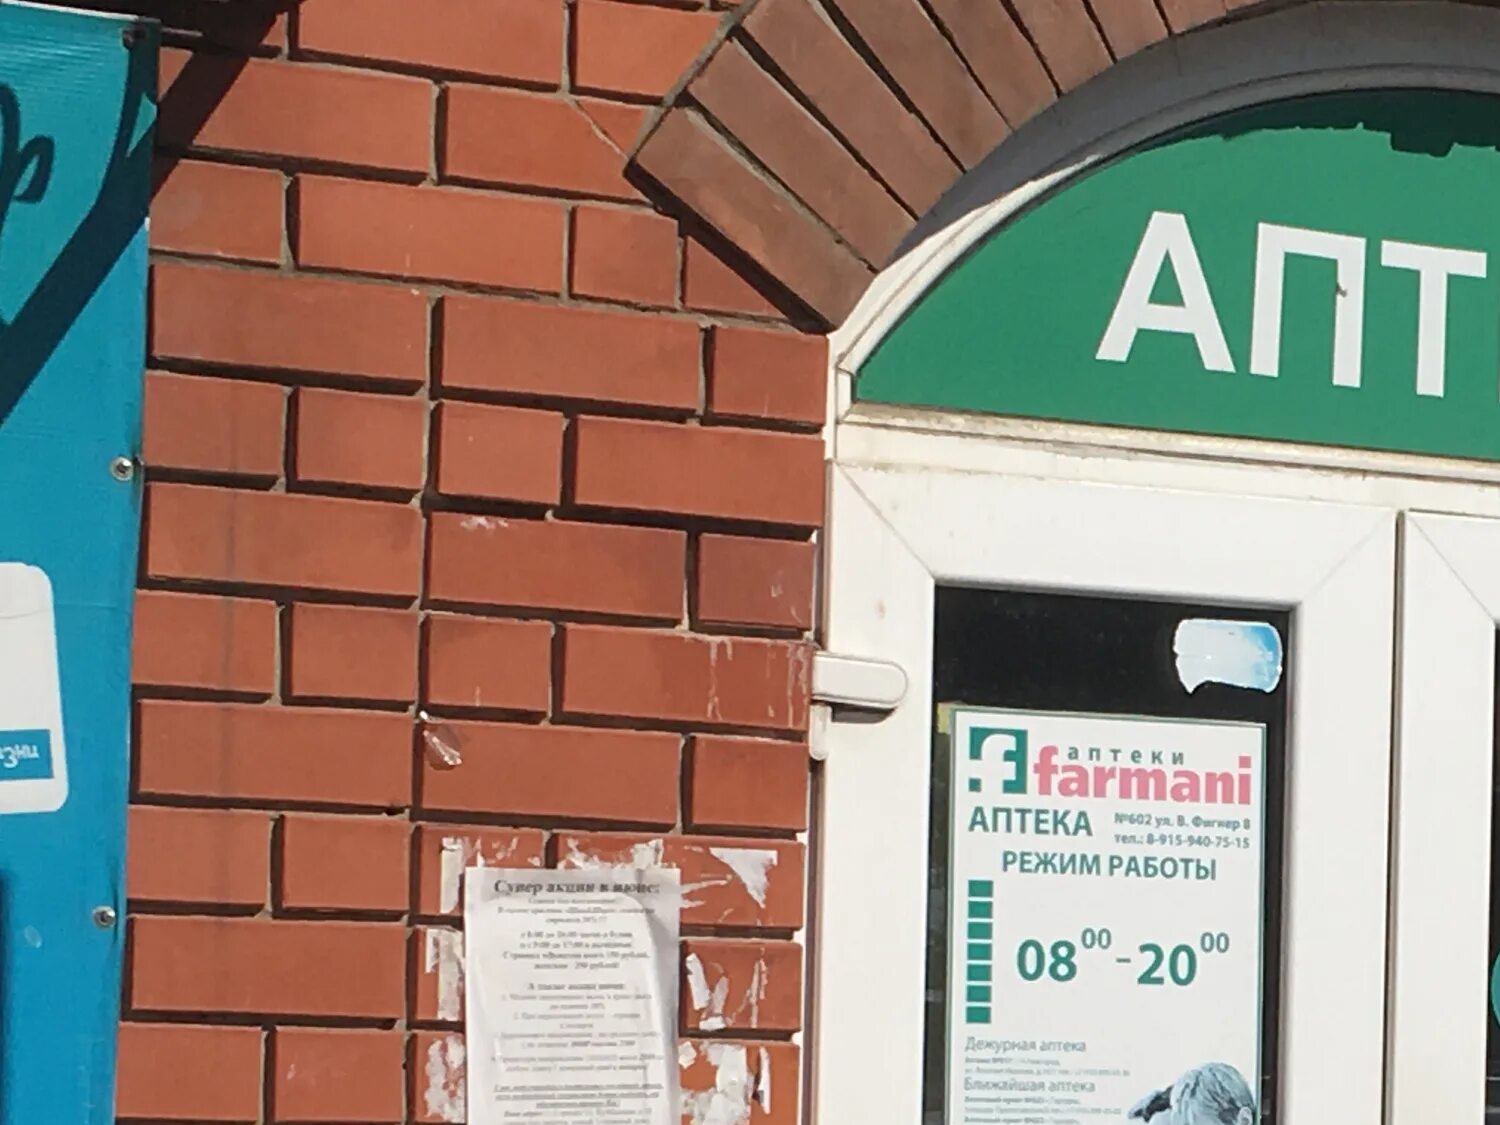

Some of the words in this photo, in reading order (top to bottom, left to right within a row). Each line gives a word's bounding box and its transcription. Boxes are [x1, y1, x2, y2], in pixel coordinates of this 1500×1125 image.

[1067, 745, 1184, 765] аптеки
[1033, 745, 1252, 805] farmani
[968, 805, 1093, 837] АПТЕКА
[1002, 850, 1100, 876] РЕЖИМ
[1109, 855, 1217, 881] РАБОТЫ
[494, 879, 543, 896] Супер
[965, 1036, 1037, 1054] Дежурная
[1039, 1039, 1087, 1052] аптека
[963, 1076, 1045, 1092] Ближайшая
[1048, 1080, 1096, 1093] аптека
